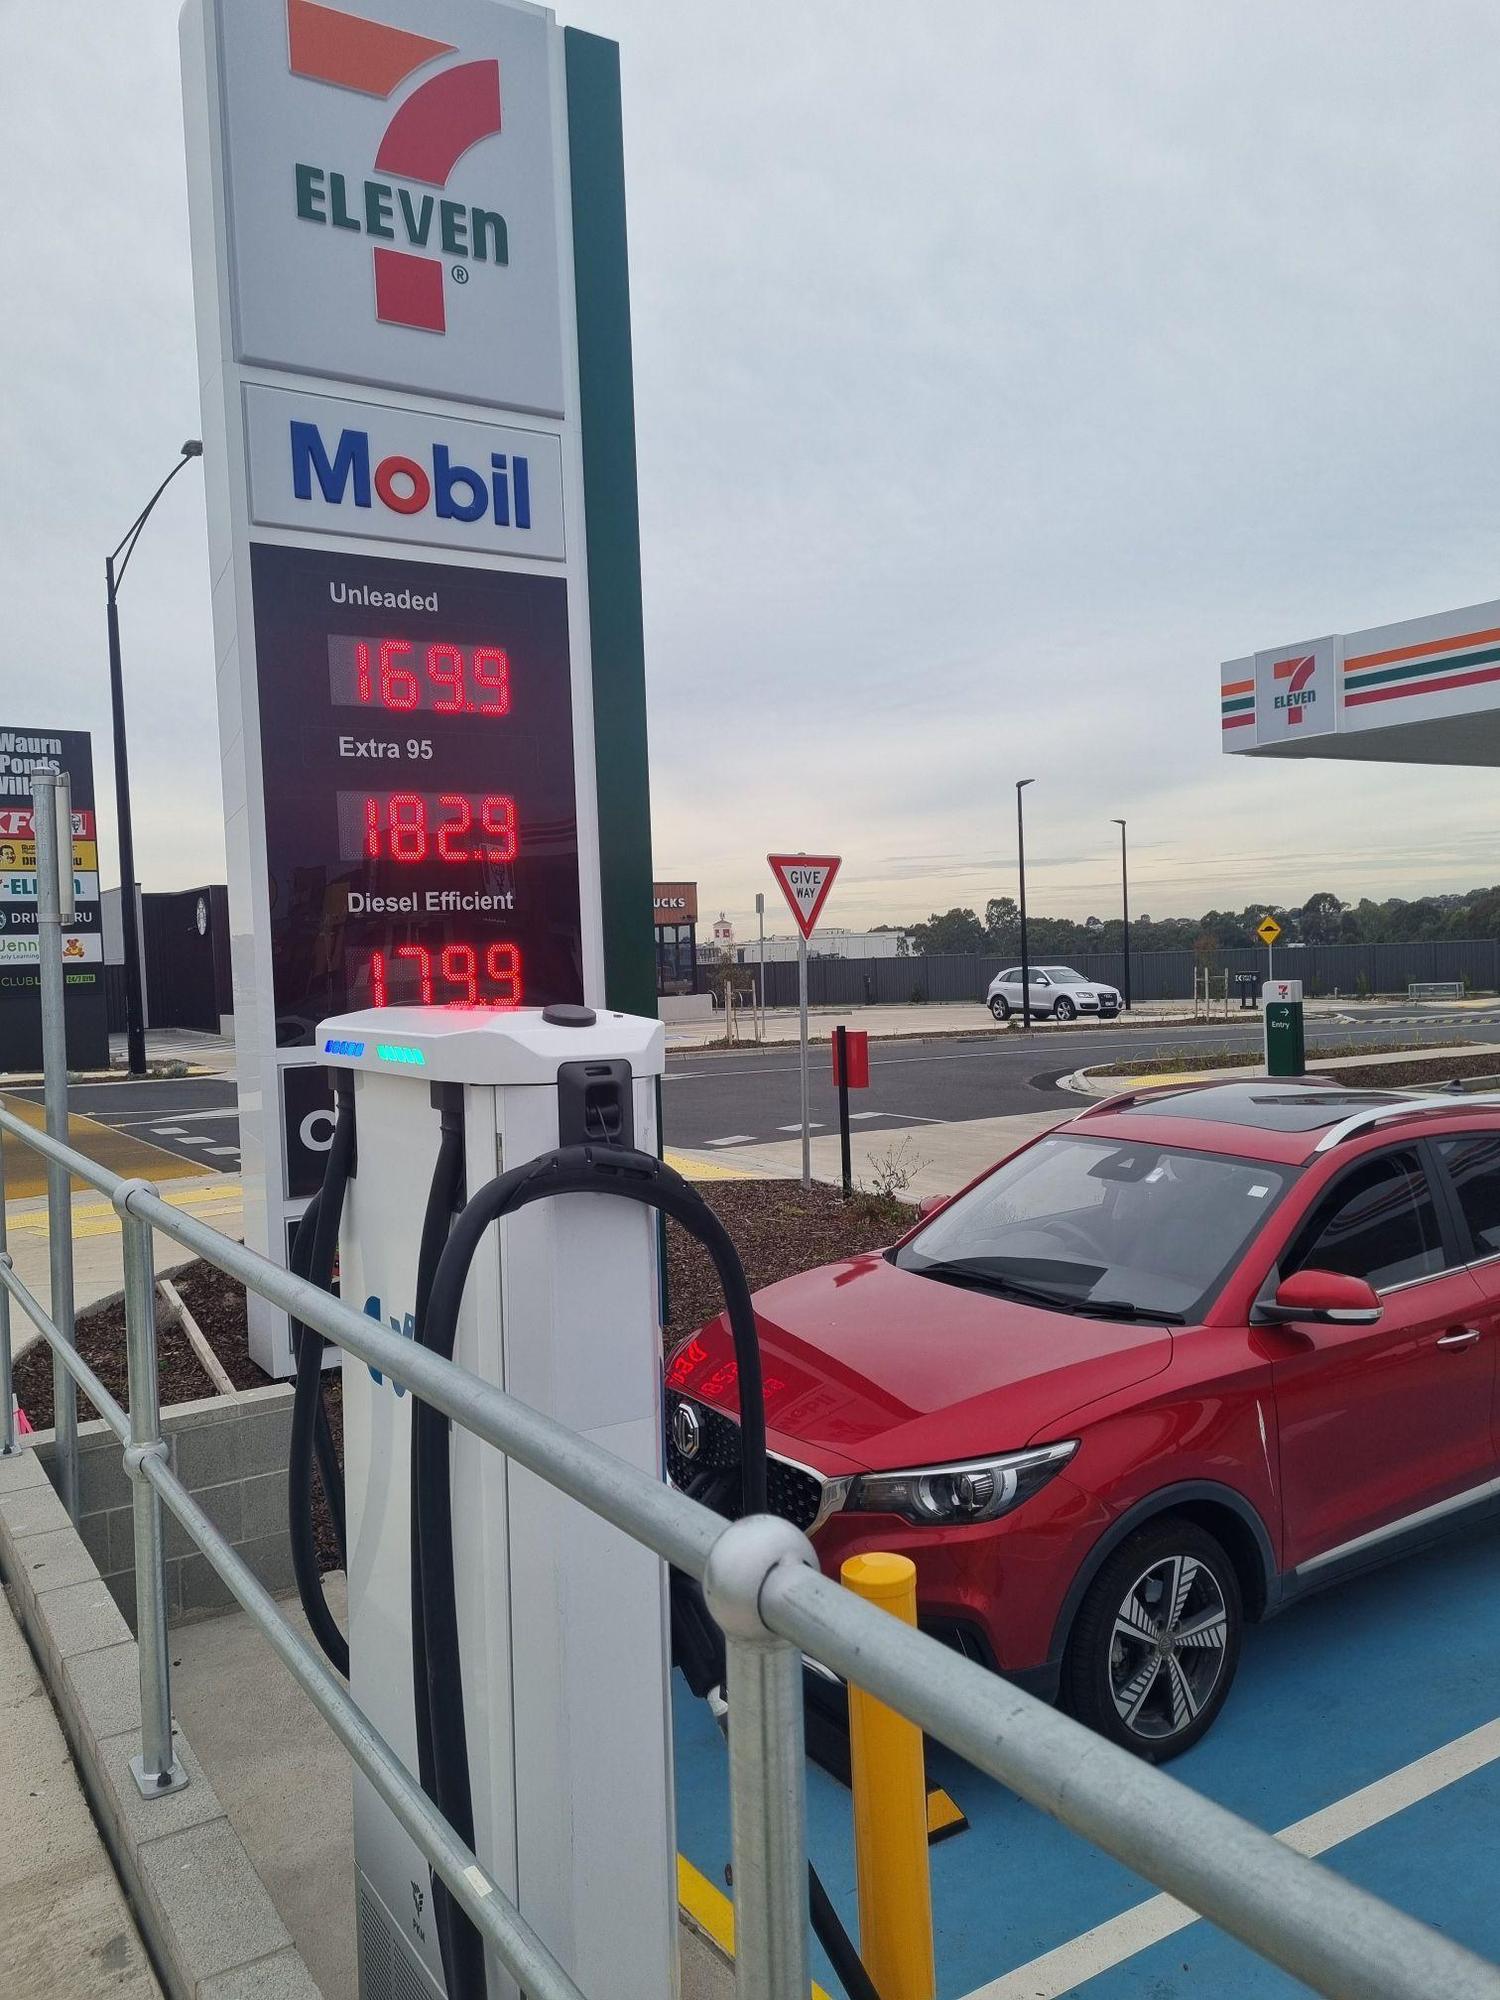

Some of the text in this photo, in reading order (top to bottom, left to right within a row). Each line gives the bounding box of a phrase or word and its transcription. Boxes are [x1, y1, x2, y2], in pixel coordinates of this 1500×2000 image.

[290, 420, 531, 530] Mobil
[329, 582, 439, 613] Unleaded
[355, 640, 510, 713] 169.9
[1273, 654, 1316, 724] 7
[0, 733, 62, 754] Waurn
[339, 736, 433, 760] Extra 95
[0, 776, 34, 795] Vill
[366, 794, 518, 860] 182.9
[790, 870, 821, 884] GIVE
[347, 890, 514, 913] Diesel Efficient
[653, 897, 686, 908] UCKS
[796, 887, 816, 898] WAY
[11, 912, 39, 924] DRI
[0, 939, 40, 952] Jenn
[373, 943, 521, 1008] 179.9
[1271, 1020, 1290, 1030] Entry
